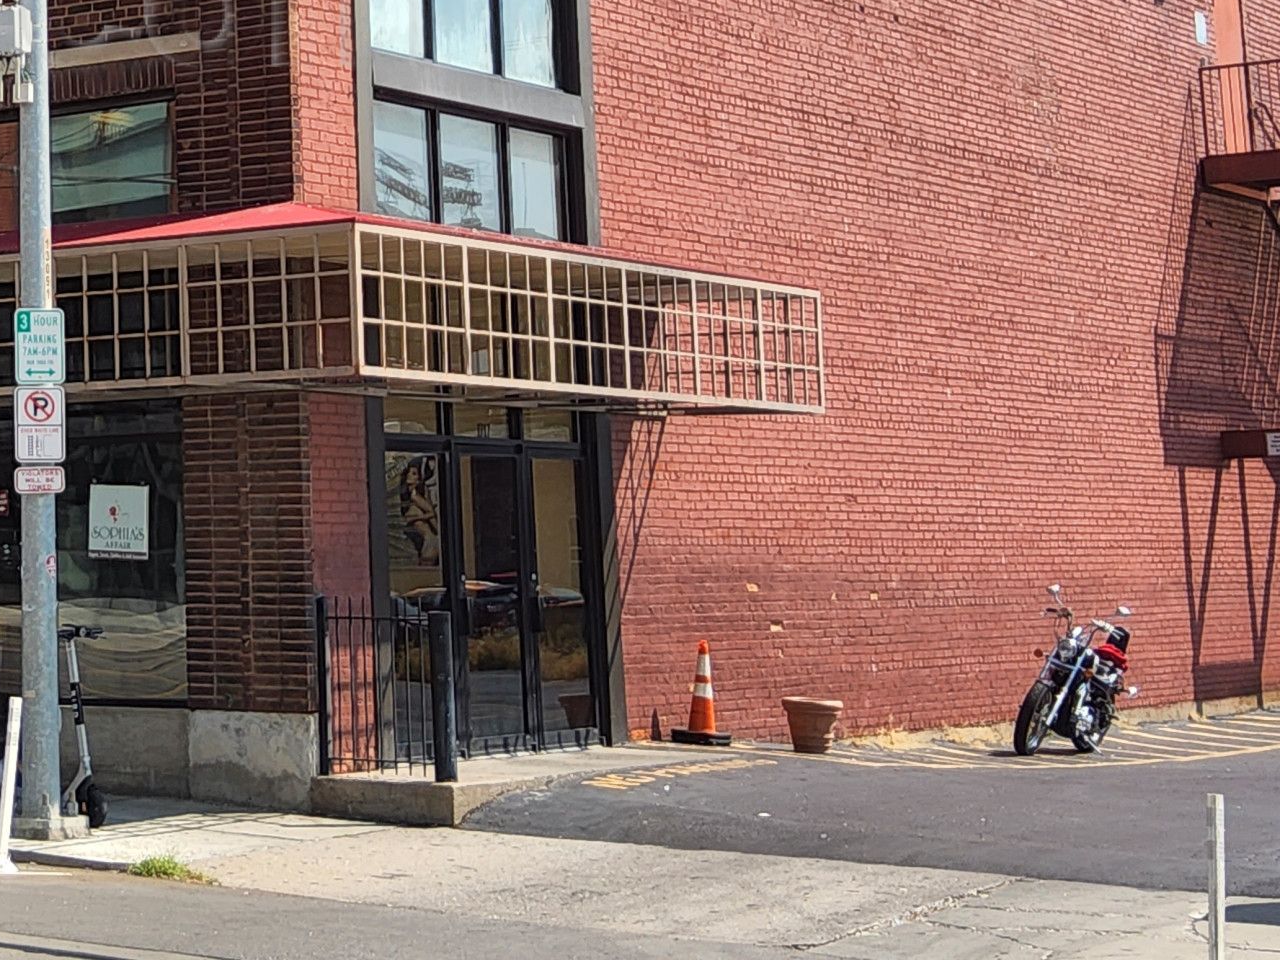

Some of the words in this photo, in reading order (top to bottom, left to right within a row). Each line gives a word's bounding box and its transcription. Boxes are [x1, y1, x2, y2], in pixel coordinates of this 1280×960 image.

[19, 313, 28, 330] 3
[33, 315, 58, 327] HOUR
[22, 334, 58, 344] PARKING
[22, 346, 58, 356] 7AM-6PM
[21, 469, 60, 477] VIOLATORS
[90, 526, 145, 541] SOPHIA'S
[104, 540, 132, 549] AFFAIR
